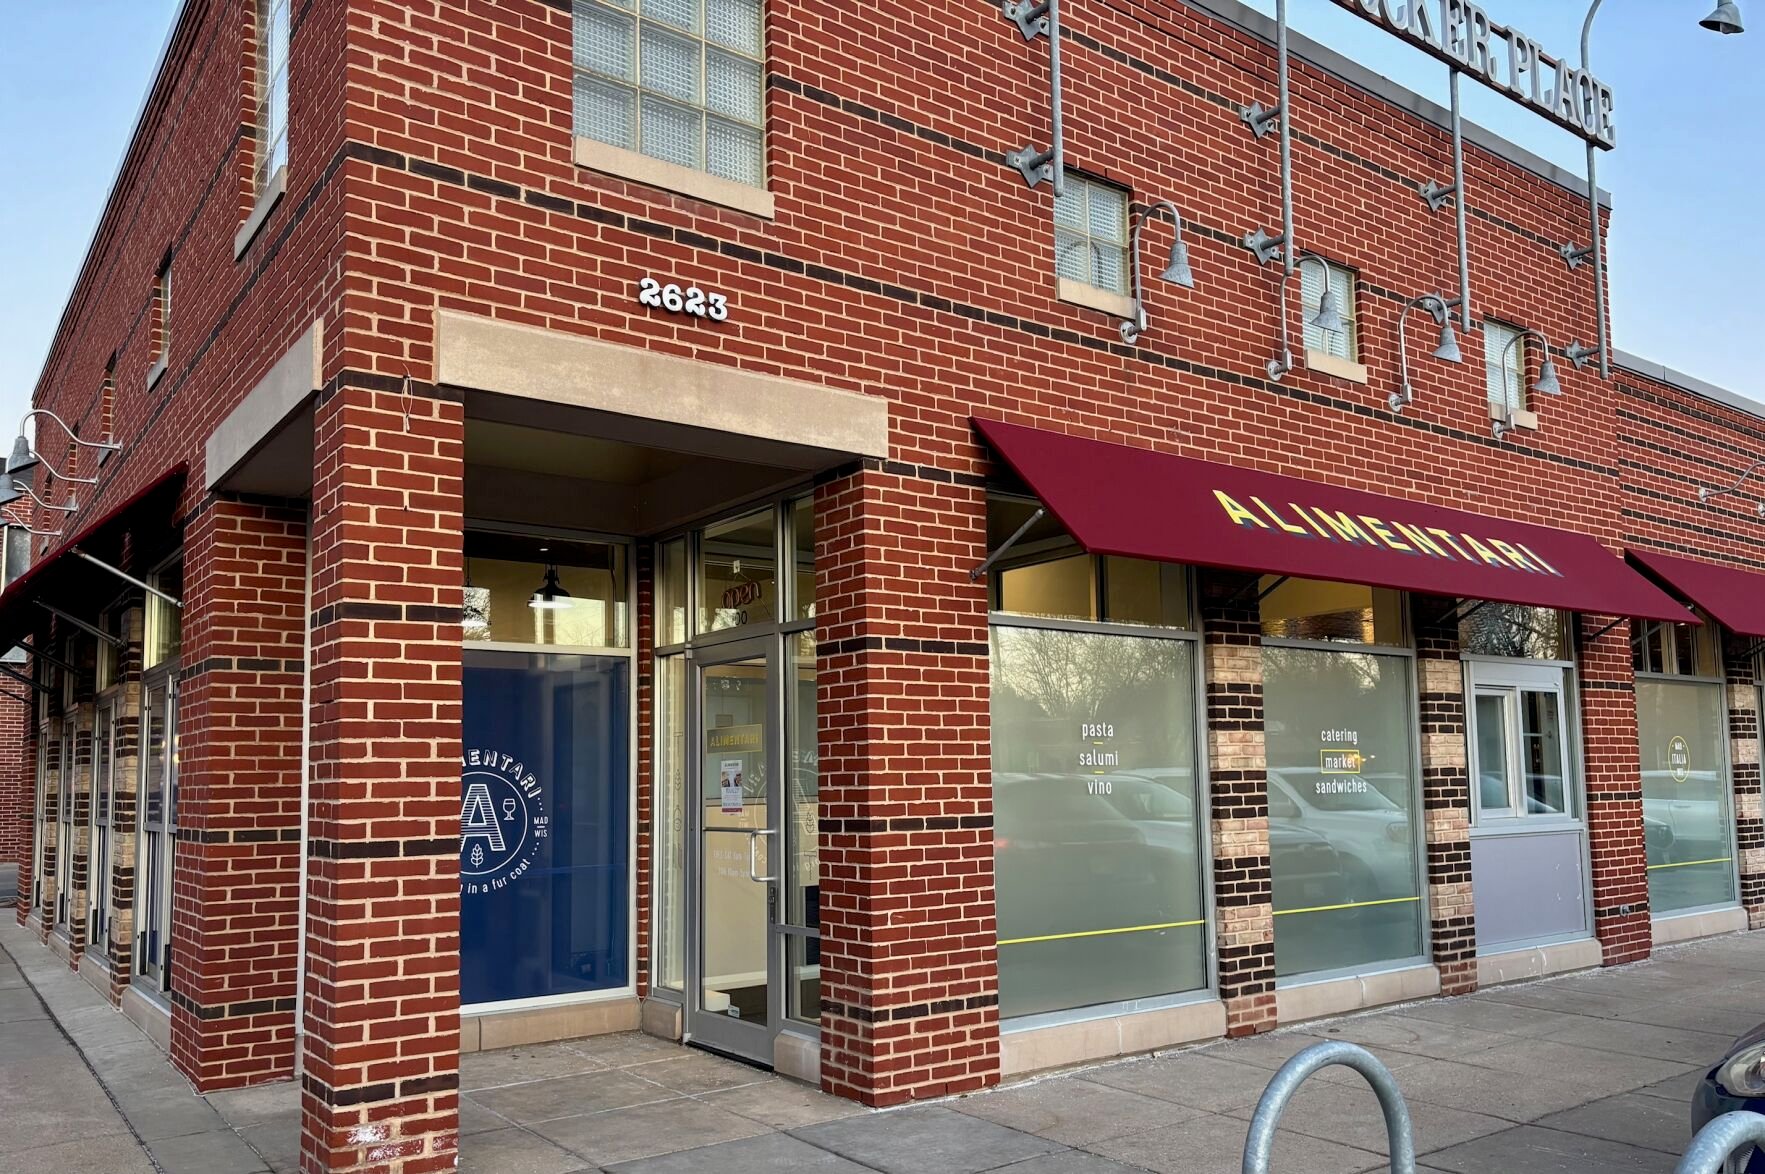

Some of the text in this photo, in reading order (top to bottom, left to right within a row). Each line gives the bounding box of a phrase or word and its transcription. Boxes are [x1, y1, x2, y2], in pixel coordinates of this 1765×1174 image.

[1502, 25, 1616, 150] PLACE
[640, 278, 728, 320] 2623
[1212, 489, 1562, 577] ALIMENTARI
[1082, 722, 1114, 741] pasta
[1321, 728, 1358, 746] catering
[1080, 749, 1119, 766] salumi
[1325, 754, 1356, 769] market
[1087, 779, 1113, 794] vino
[1315, 779, 1368, 794] sandwiches
[461, 784, 506, 852] A
[533, 816, 549, 825] MAD
[534, 829, 548, 838] WIS
[467, 883, 478, 894] in
[482, 884, 489, 893] a
[491, 876, 508, 891] fur
[510, 858, 531, 880] coat
